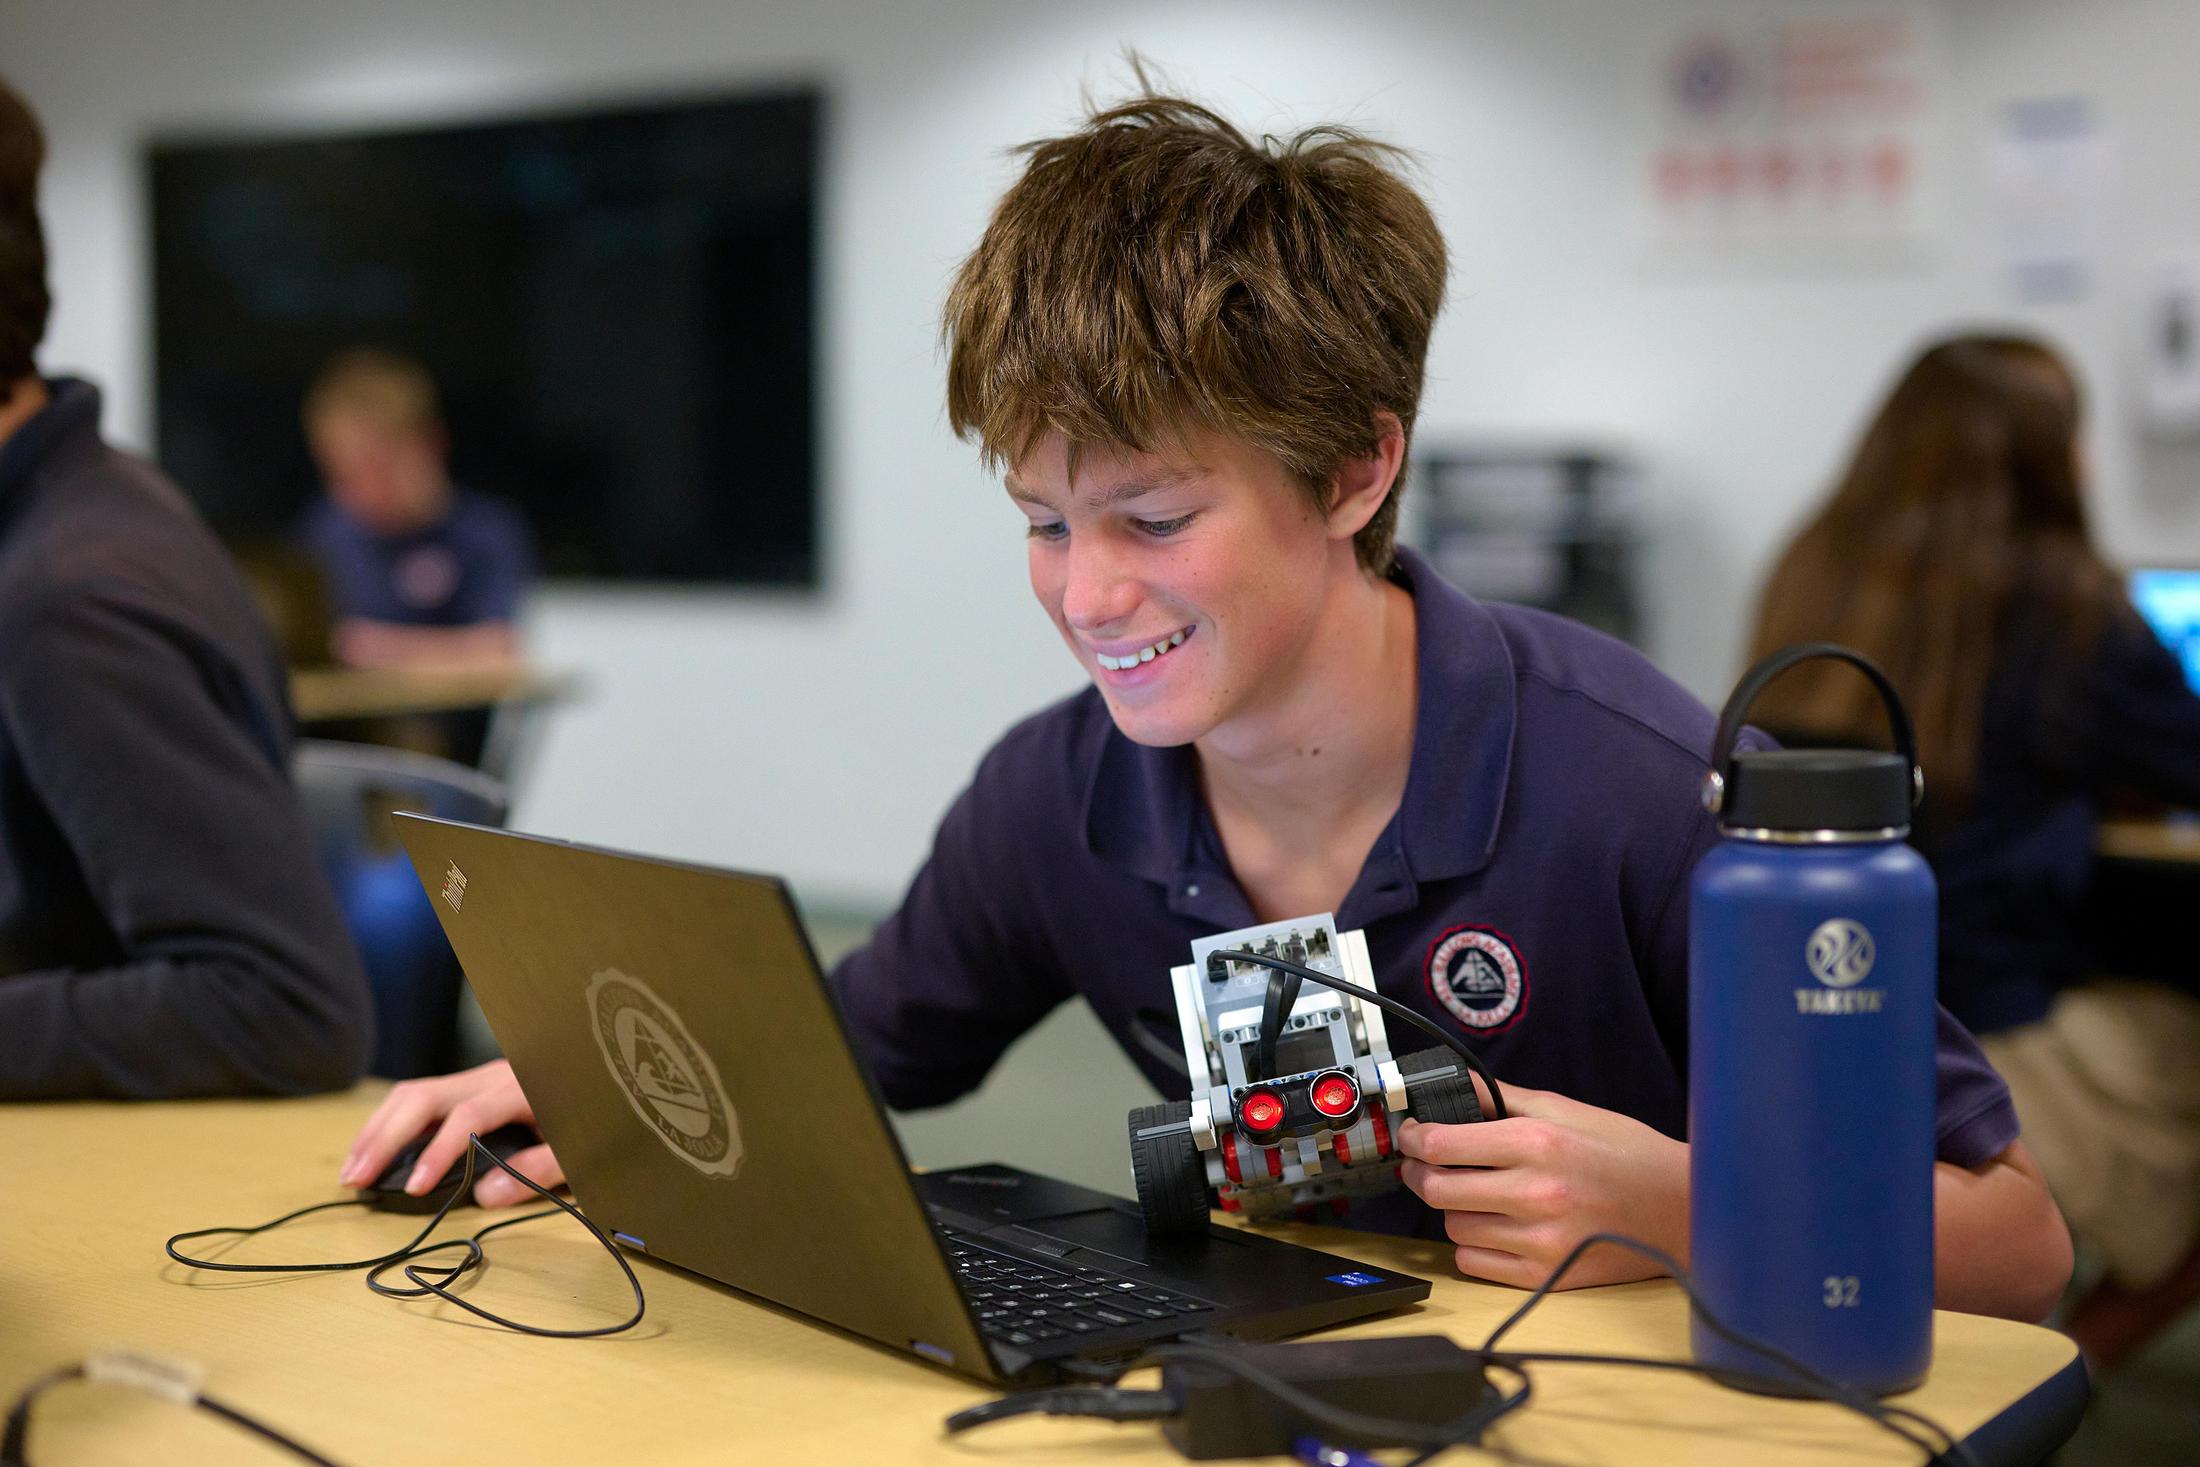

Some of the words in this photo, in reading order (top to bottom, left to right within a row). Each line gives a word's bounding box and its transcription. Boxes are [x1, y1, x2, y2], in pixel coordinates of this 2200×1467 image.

[441, 858, 468, 914] ThinkPad
[1794, 989, 1882, 1015] TAKEYA
[1823, 1276, 1861, 1309] 32
